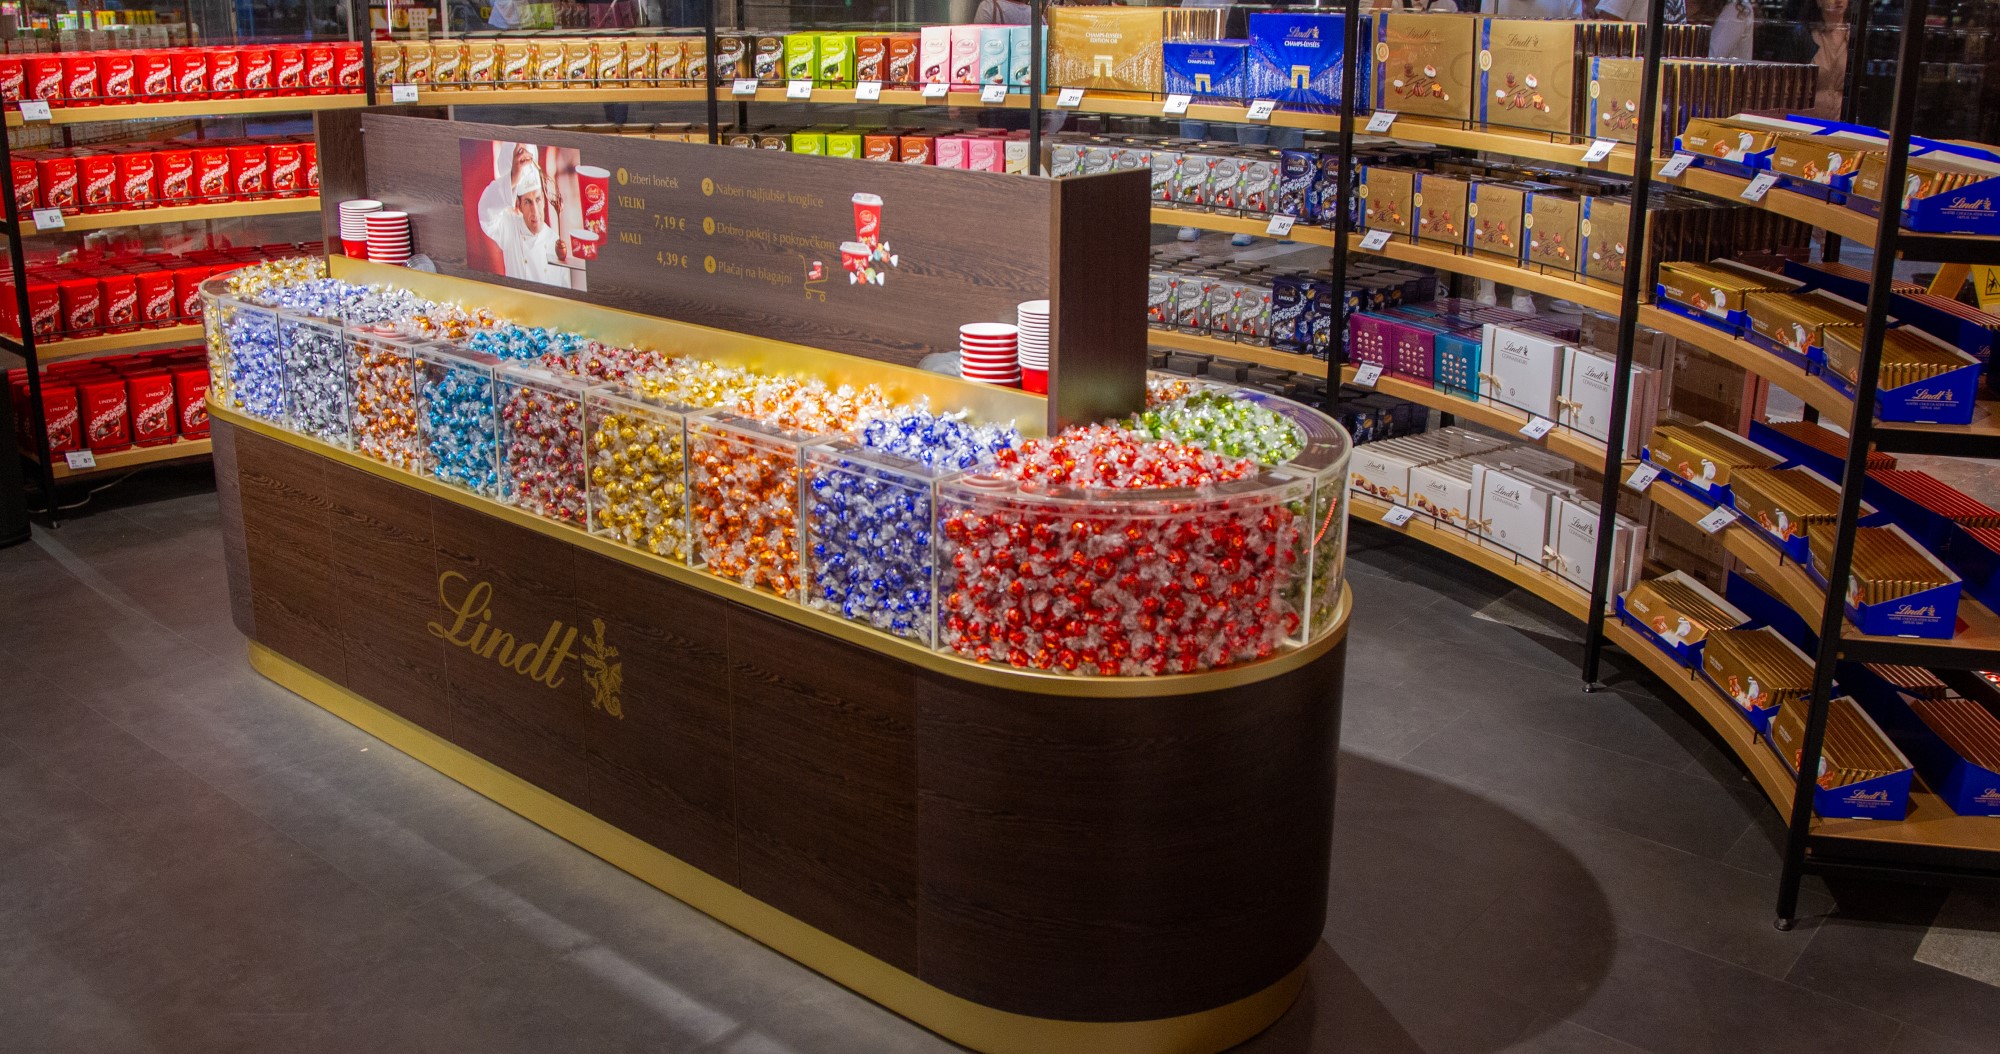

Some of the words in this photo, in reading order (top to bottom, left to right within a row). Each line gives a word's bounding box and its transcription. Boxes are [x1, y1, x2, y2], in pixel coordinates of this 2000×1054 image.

[1286, 26, 1312, 38] Lindt
[1507, 33, 1532, 48] Lindt
[630, 172, 651, 183] Izberi
[653, 175, 679, 189] lonček
[618, 196, 645, 209] VELIKI
[716, 183, 744, 196] Naberi
[747, 187, 785, 202] najljubše
[788, 192, 824, 208] kroglice
[1949, 197, 1983, 210] Lindt
[654, 214, 676, 230] 7,19
[679, 218, 685, 231] €
[620, 232, 642, 245] MALI
[718, 222, 743, 236] Dobro
[746, 227, 770, 243] pokrij
[773, 233, 777, 241] s
[779, 232, 835, 250] pokrovčkom
[656, 251, 678, 266] 4,39
[681, 255, 687, 268] €
[718, 261, 743, 279] Plačaj
[746, 268, 756, 278] na
[759, 267, 792, 286] blagajni
[1504, 340, 1523, 354] Lindt
[1585, 365, 1604, 380] Lindt
[1912, 389, 1944, 400] Lindt
[1494, 484, 1514, 498] Lindt
[1570, 516, 1588, 531] Lindt
[1895, 605, 1926, 615] Lindt
[427, 570, 578, 689] Lindt
[1850, 789, 1880, 799] Lindt
